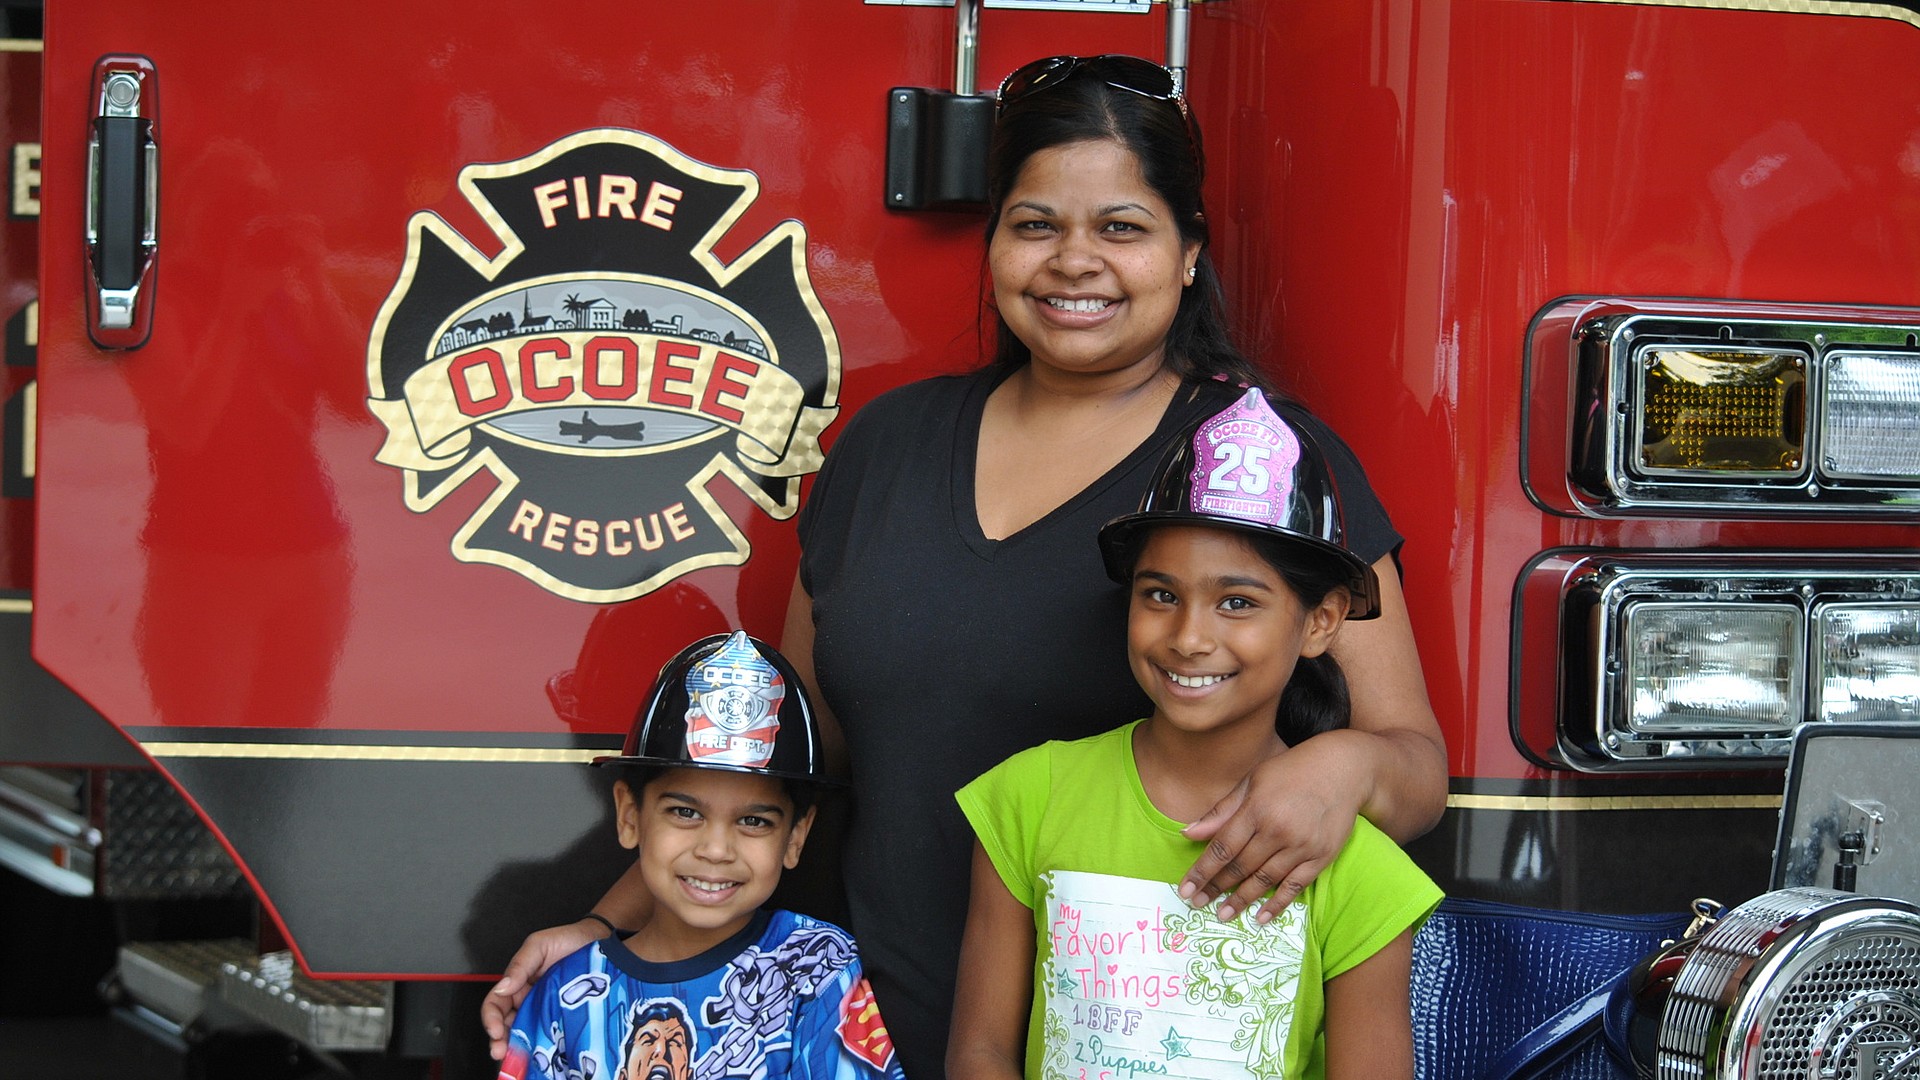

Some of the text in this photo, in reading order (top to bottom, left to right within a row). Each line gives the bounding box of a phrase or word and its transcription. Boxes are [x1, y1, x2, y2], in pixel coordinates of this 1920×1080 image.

[533, 174, 684, 231] FIRE
[447, 335, 761, 424] OCOEE
[1213, 422, 1280, 447] OCOEE FD
[1207, 442, 1271, 496] 25
[508, 499, 696, 556] RESCUE
[1204, 497, 1268, 515] FIREFIGHTER
[703, 666, 772, 689] OCOEE
[700, 734, 728, 749] FIRE
[1052, 906, 1189, 957] Favorite
